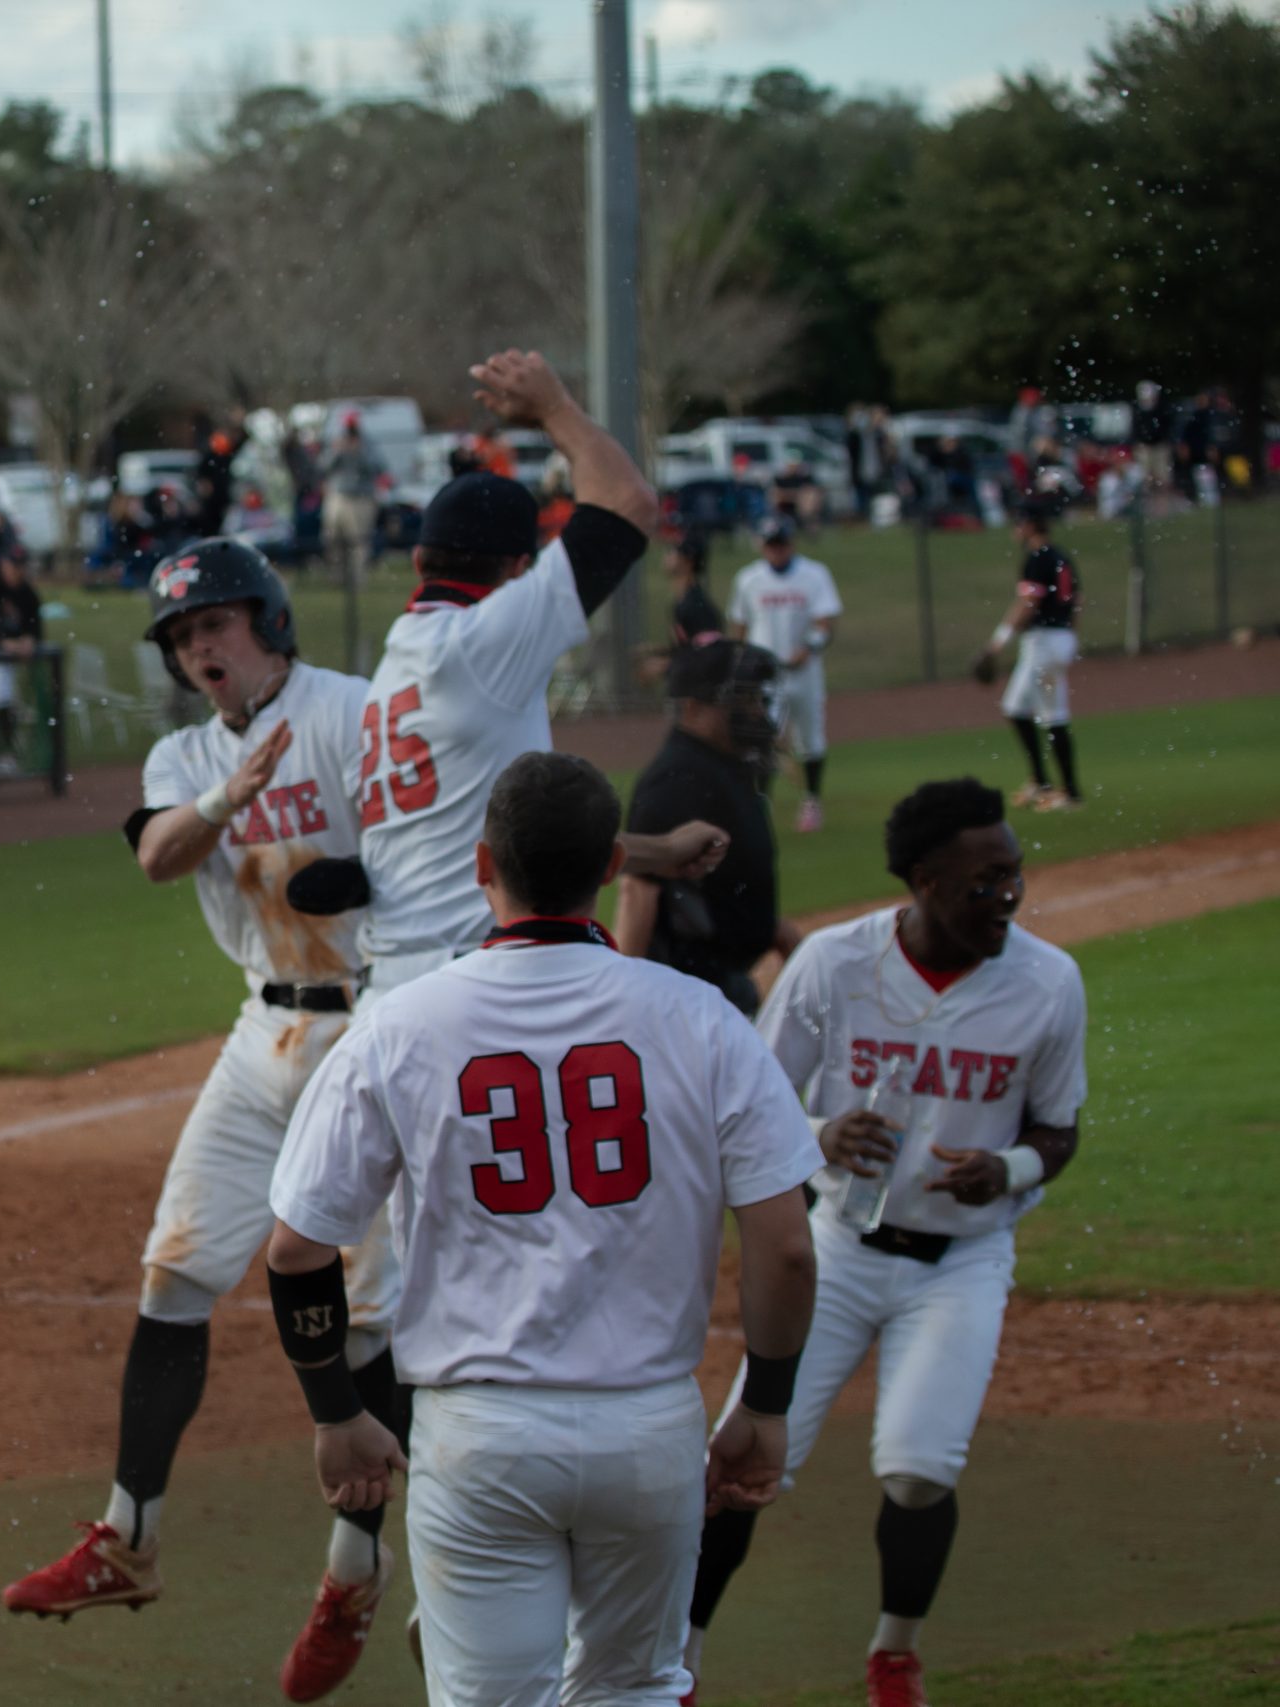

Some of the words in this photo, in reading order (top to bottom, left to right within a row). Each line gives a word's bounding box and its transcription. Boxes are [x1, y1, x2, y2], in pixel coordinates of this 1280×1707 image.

[360, 684, 439, 828] 25
[459, 1041, 651, 1214] 38
[851, 1039, 1018, 1102] STATE
